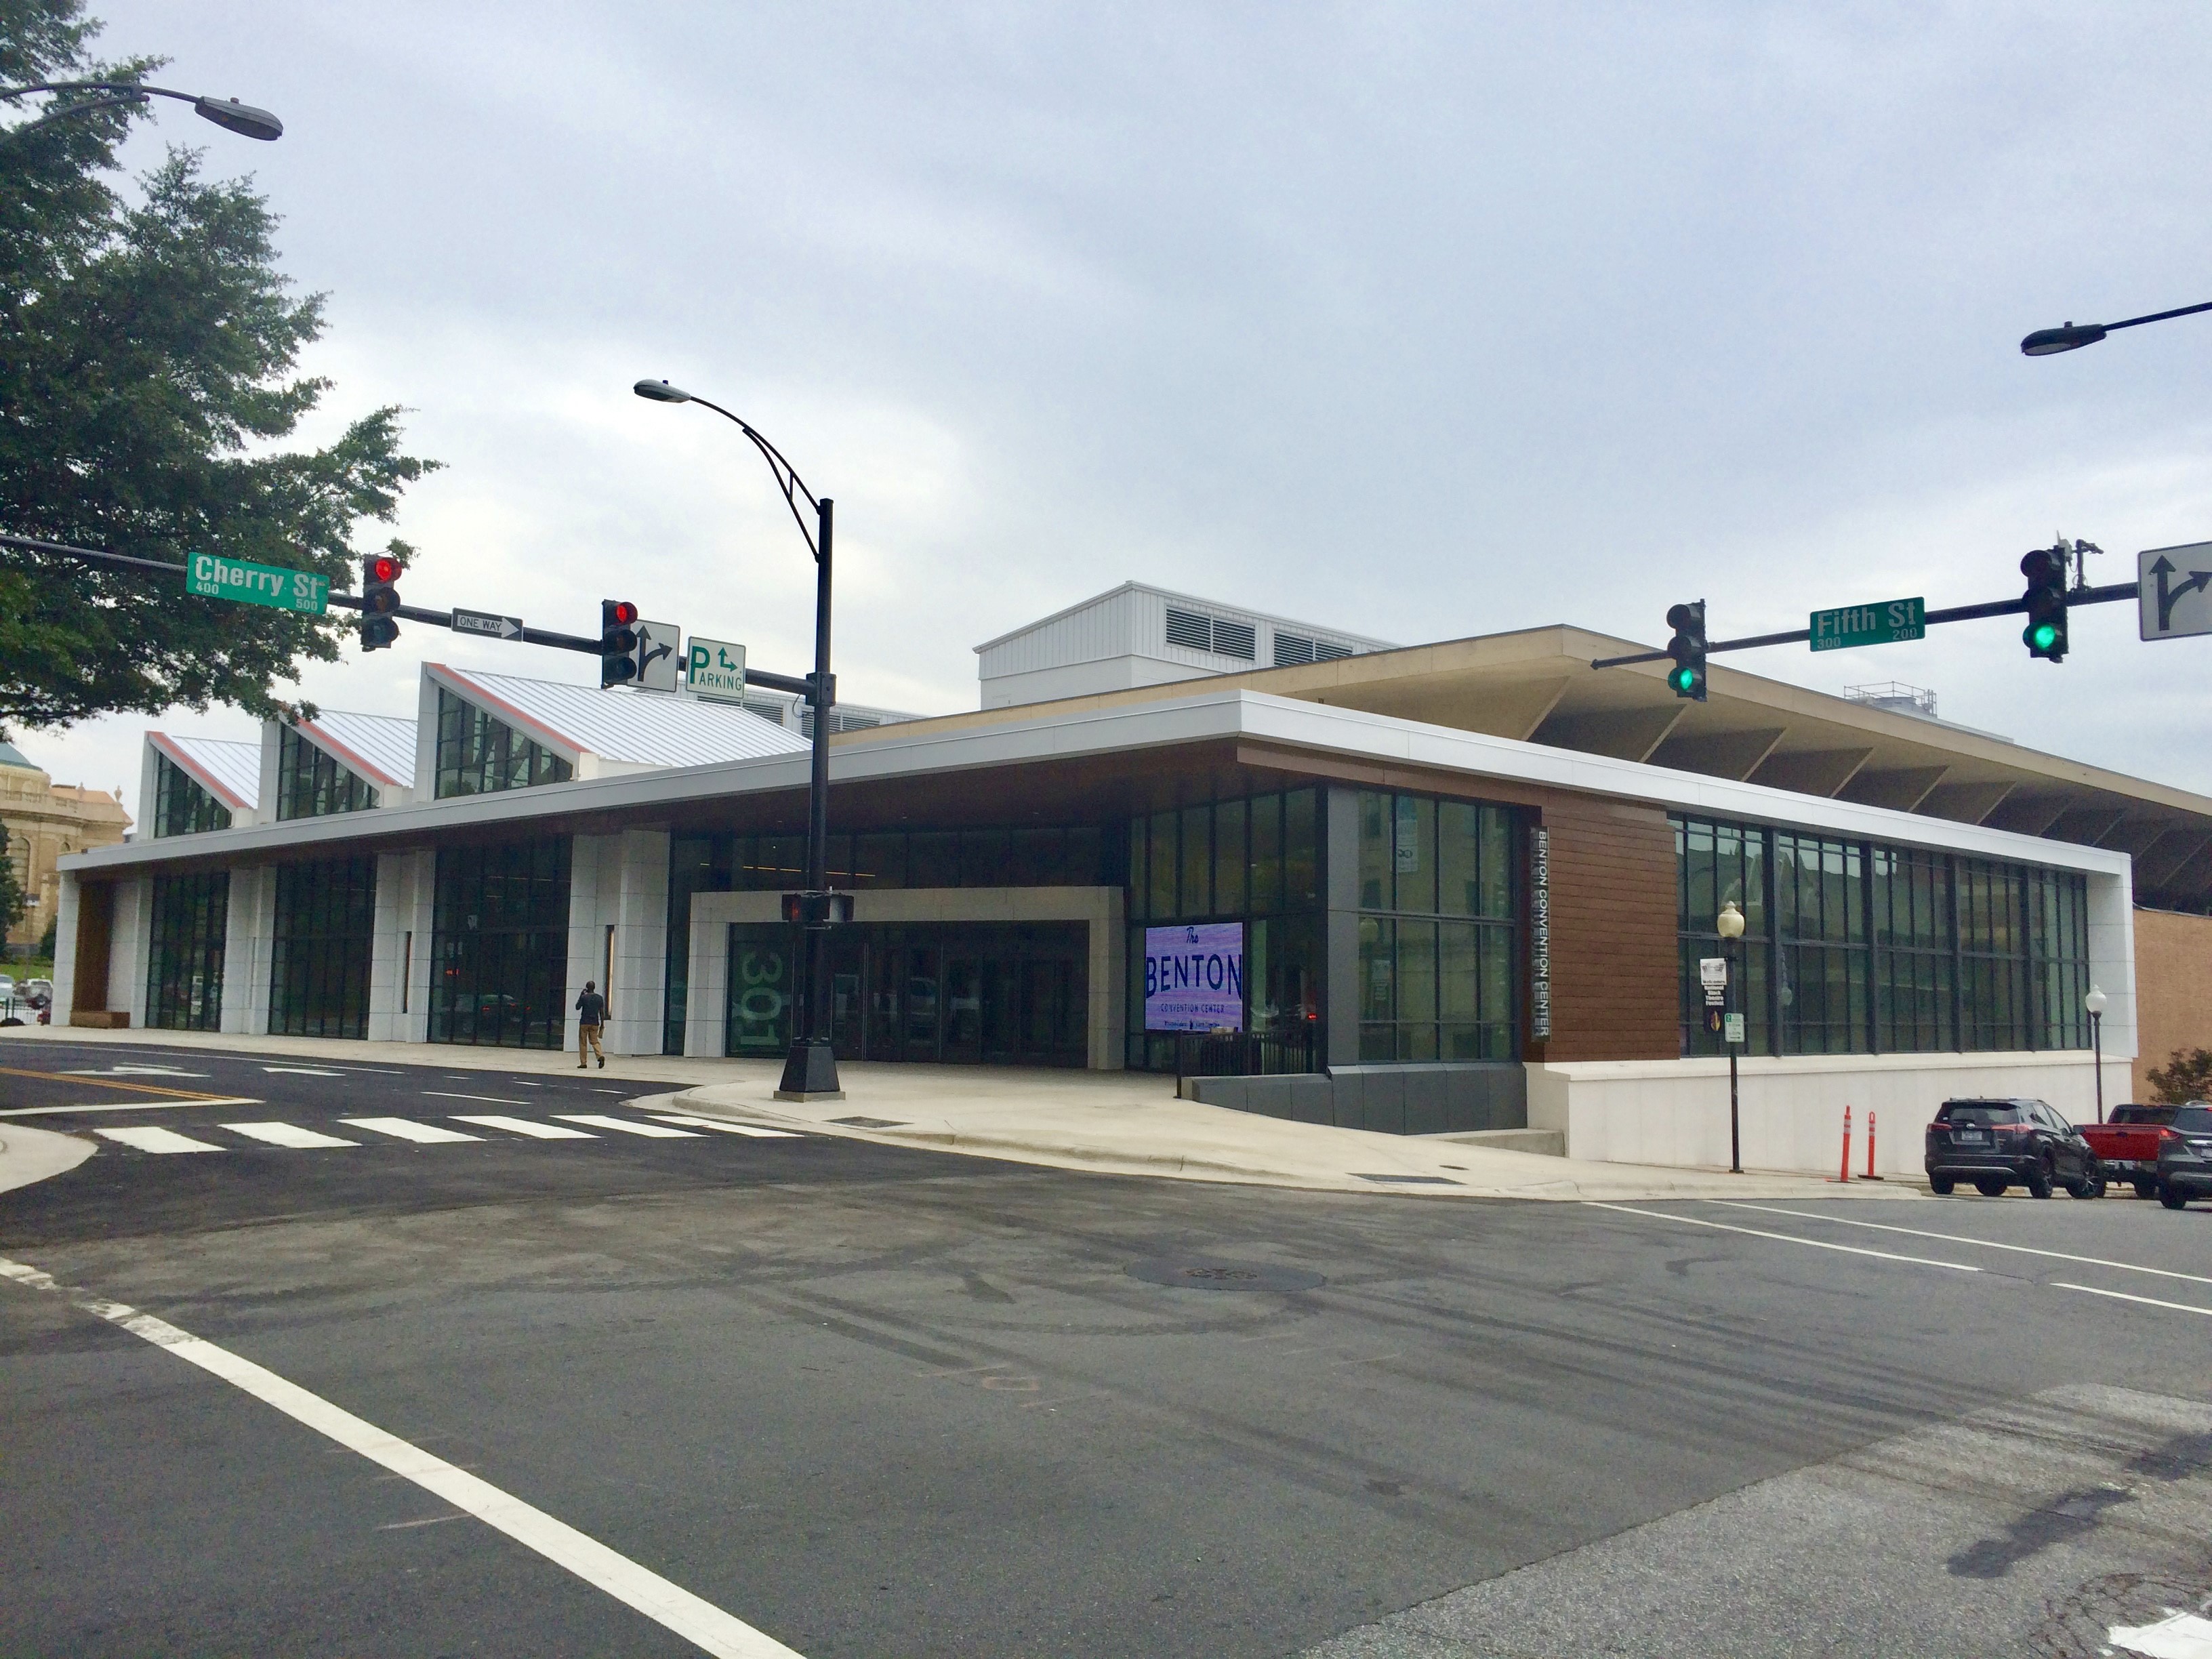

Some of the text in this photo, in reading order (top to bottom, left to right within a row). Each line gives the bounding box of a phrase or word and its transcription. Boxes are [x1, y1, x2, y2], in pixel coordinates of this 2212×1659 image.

[195, 556, 318, 599] Cherry St
[196, 581, 219, 594] 400
[296, 598, 318, 611] 500
[460, 616, 501, 632] ONE WAY
[1817, 602, 1917, 637] Fifth St
[1817, 636, 1841, 649] 300
[1893, 627, 1918, 640] 200
[690, 645, 742, 691] PARKING
[1186, 926, 1199, 944] The
[1538, 830, 1549, 1037] BENTON CONVENTION CENTER
[1145, 954, 1242, 1000] BENTON
[741, 950, 783, 1046] 301
[1160, 1003, 1225, 1014] CONVENTION CENTER
